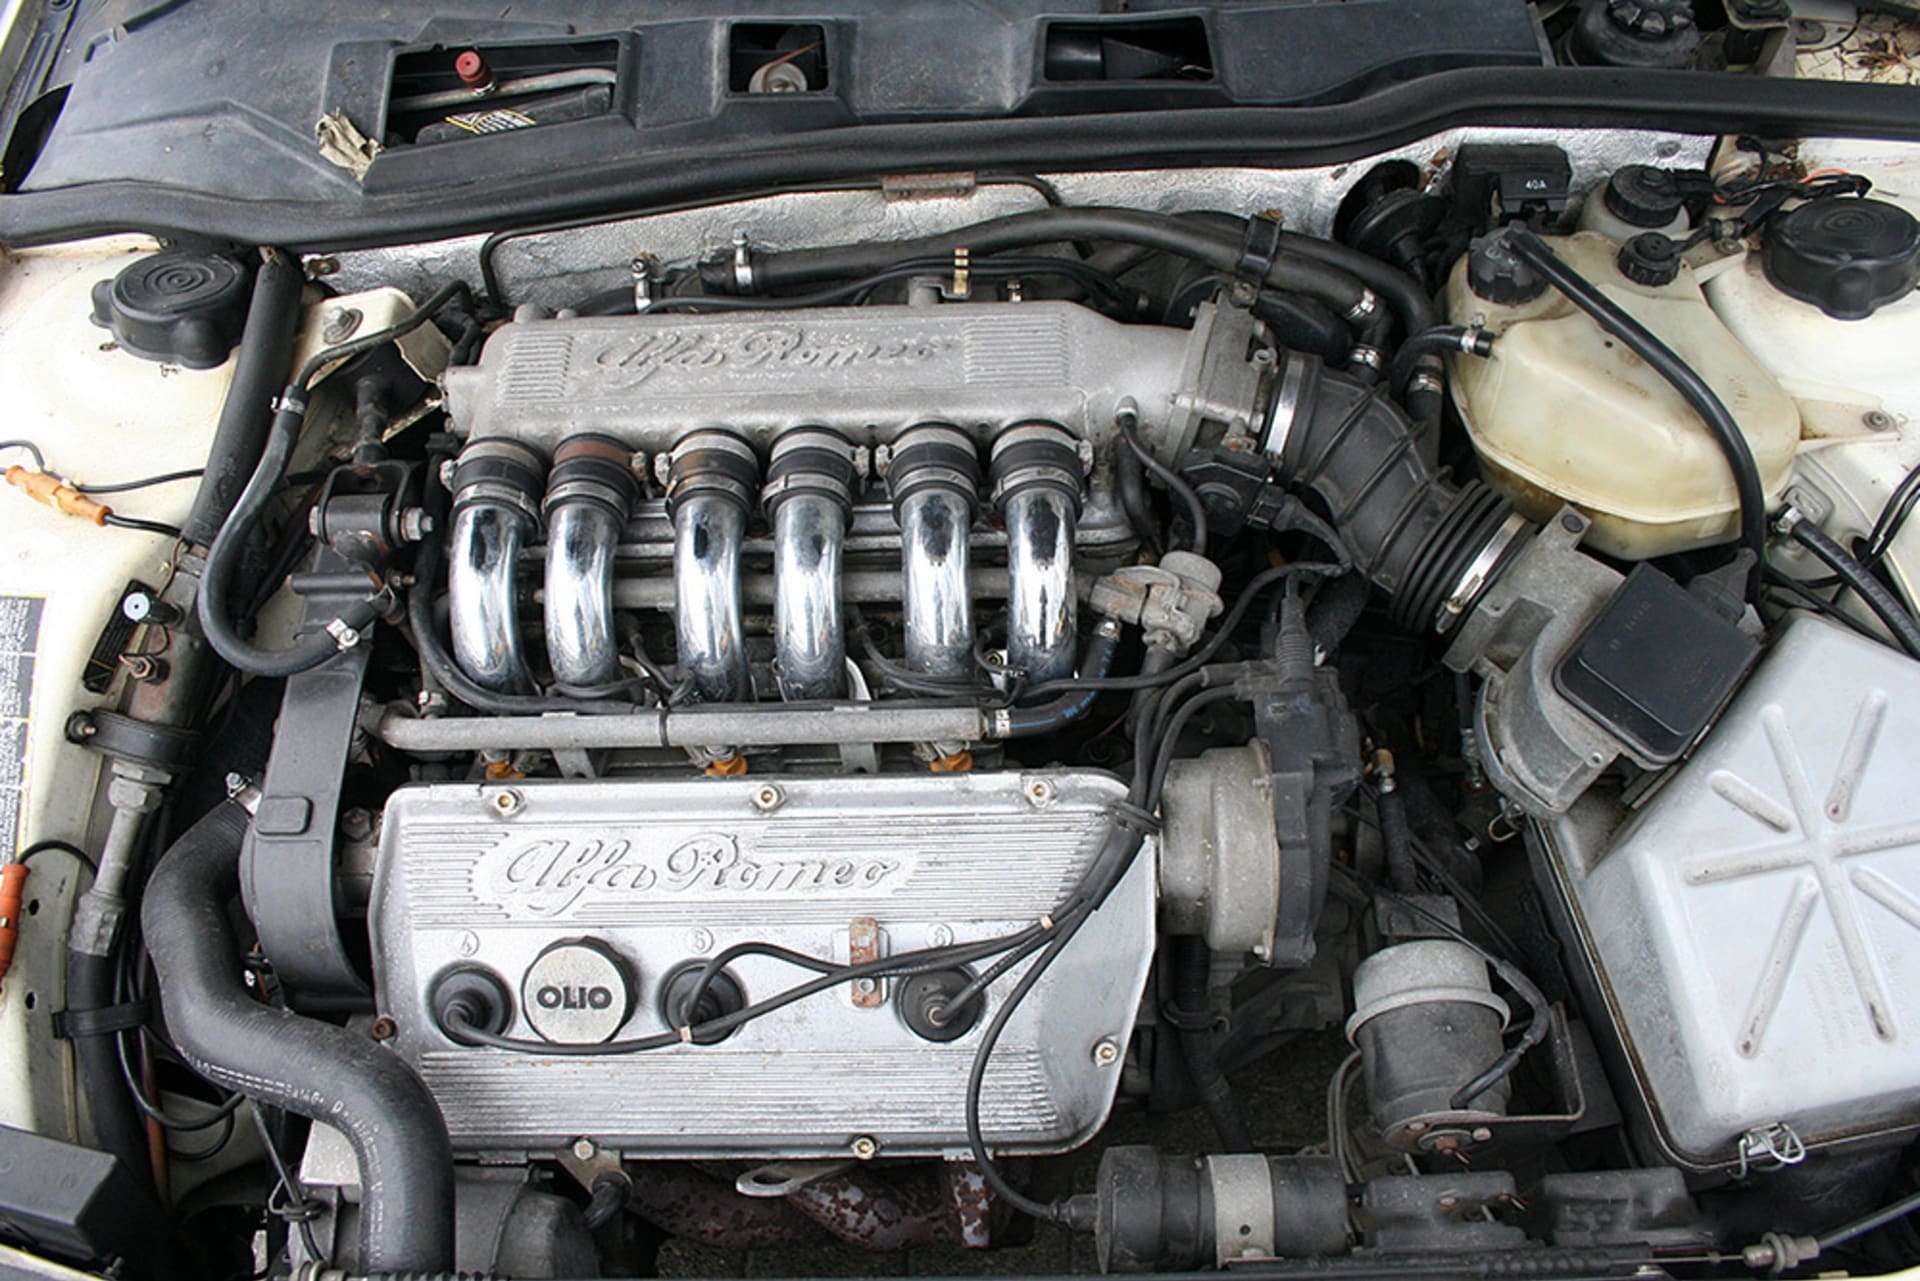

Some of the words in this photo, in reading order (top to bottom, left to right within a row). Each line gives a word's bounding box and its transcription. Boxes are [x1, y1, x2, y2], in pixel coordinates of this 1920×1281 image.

[1525, 179, 1547, 190] 40A
[596, 333, 726, 391] Alfa
[505, 838, 657, 917] Alfa
[666, 831, 899, 890] Romeo
[537, 985, 613, 1010] OLIO
